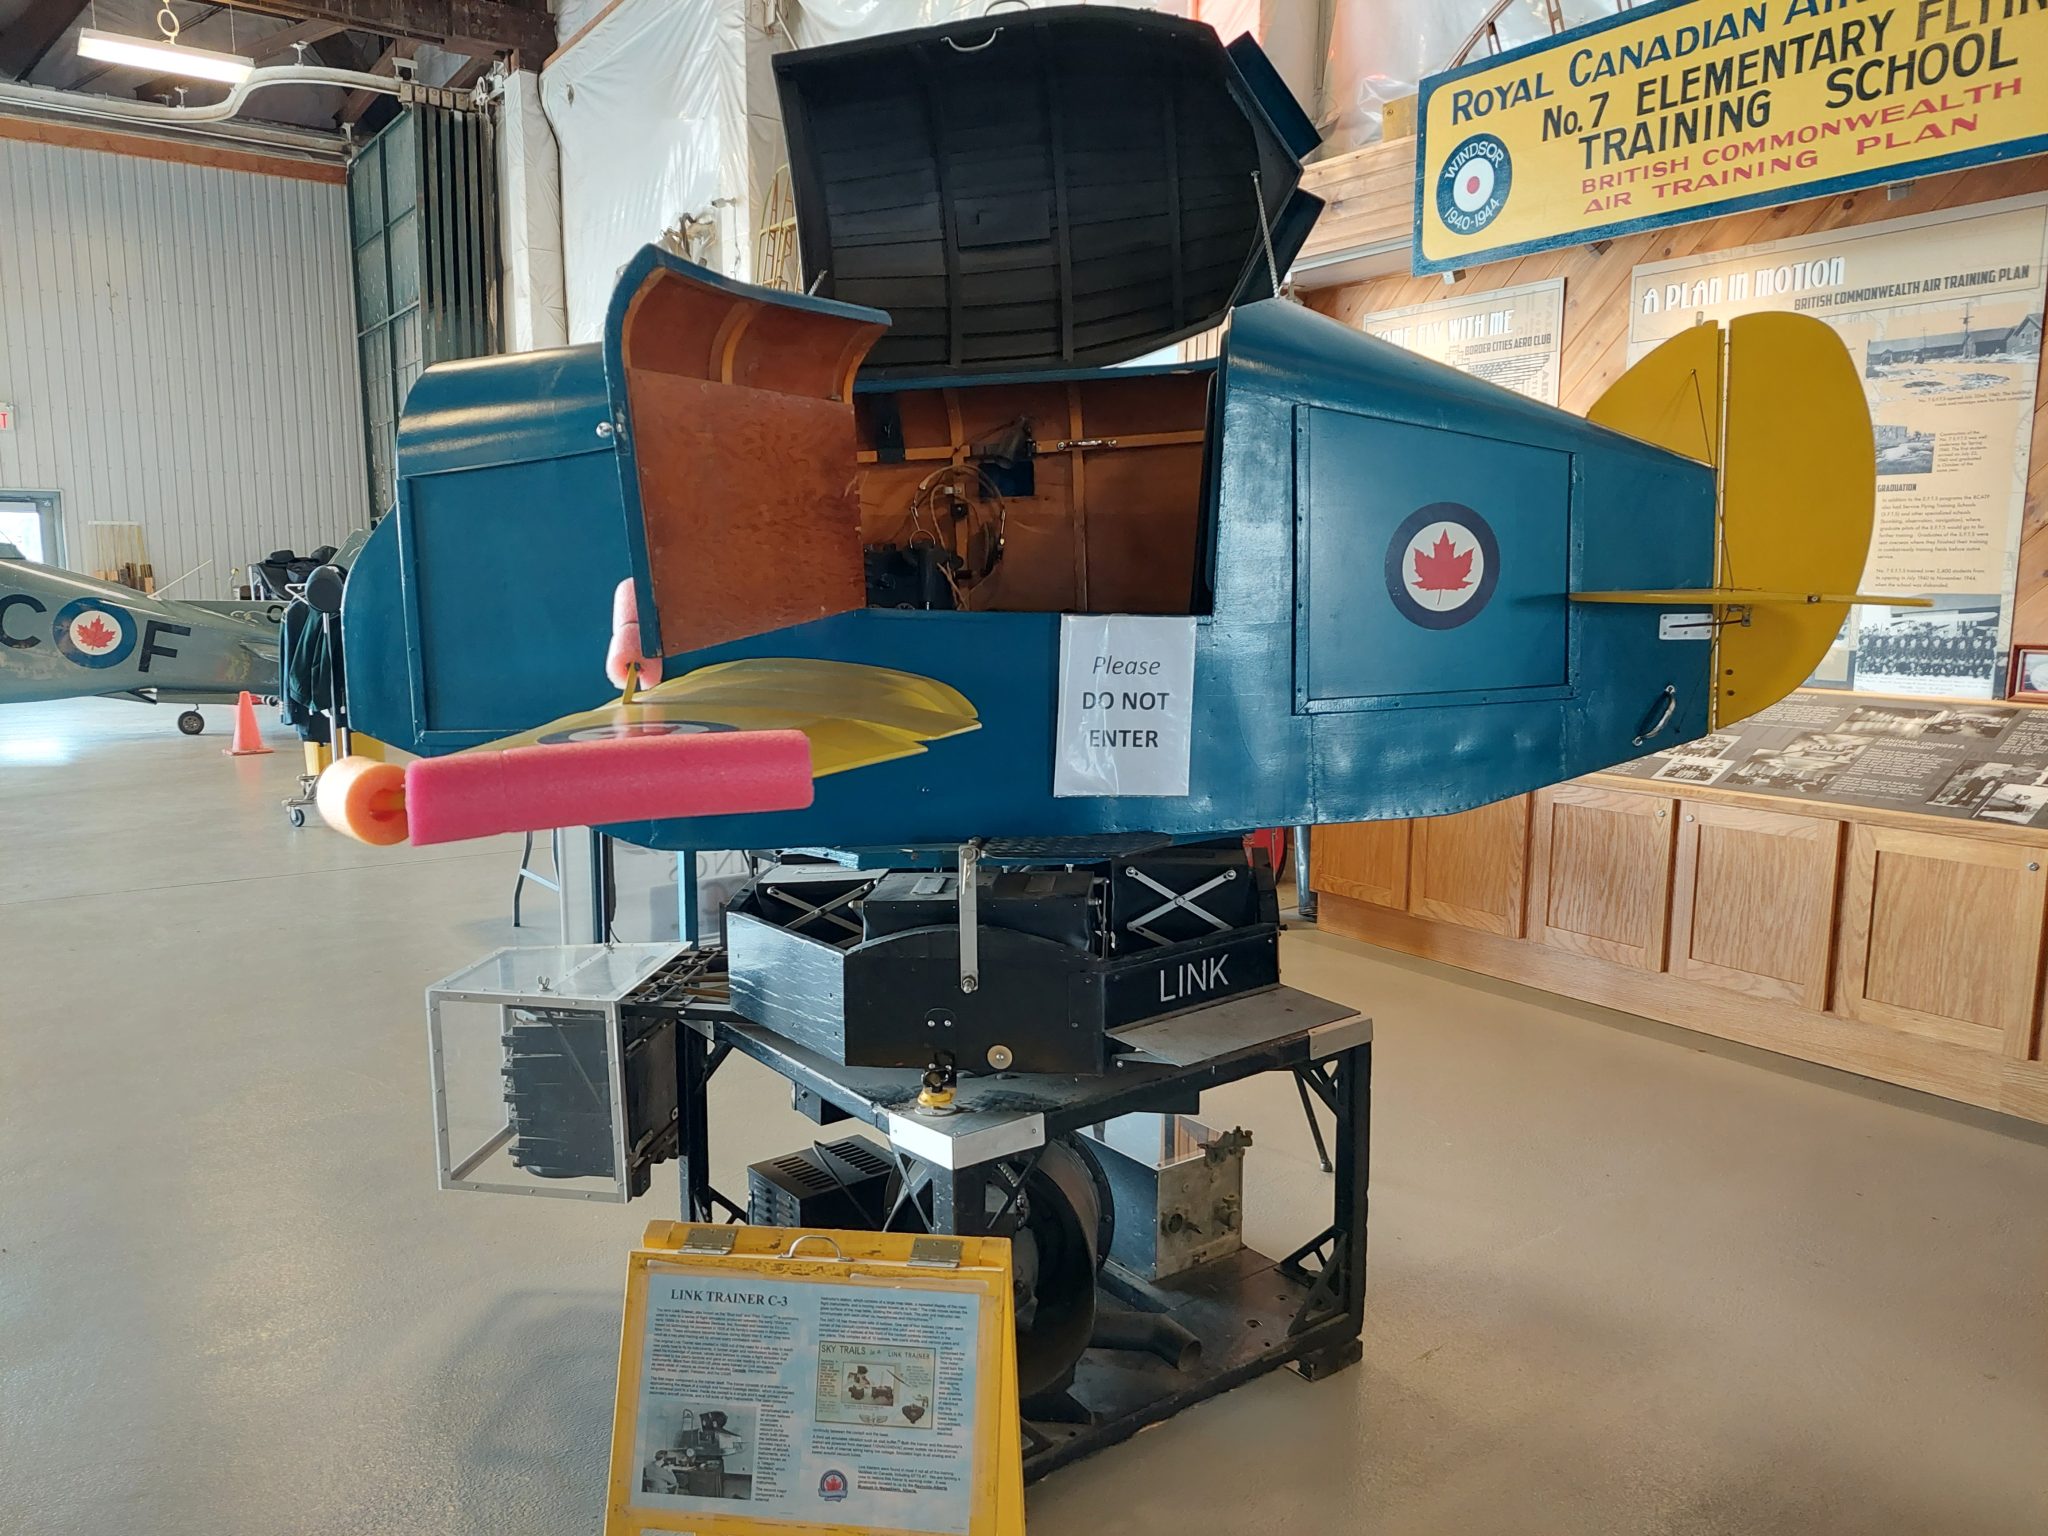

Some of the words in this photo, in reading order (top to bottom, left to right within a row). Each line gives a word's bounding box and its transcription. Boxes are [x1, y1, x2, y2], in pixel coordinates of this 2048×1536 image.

[1452, 72, 1554, 126] ROYAL
[1569, 3, 1767, 87] CANADIAN
[1636, 8, 1896, 117] ELEMENTARY
[1578, 89, 1771, 170] TRAINING
[1825, 26, 2018, 110] SCHOOL
[1582, 156, 1689, 195] BRITISH
[1703, 77, 2022, 166] COMMONWEALTH
[1444, 140, 1504, 179] WINDSOR
[1583, 191, 1632, 215] AIR
[1652, 150, 1818, 199] TRAINING
[1856, 113, 1979, 156] PLAN
[1444, 198, 1500, 231] 1940-1944
[1642, 287, 1660, 315] A
[1664, 276, 1722, 312] PLAN
[1728, 272, 1750, 303] IN
[1755, 256, 1846, 298] MOTION
[1794, 294, 1832, 311] BRITISH
[1834, 280, 1920, 306] COMMONWEALTH
[1922, 277, 1941, 293] AIR
[1943, 268, 1996, 290] TRAINING
[1998, 264, 2030, 283] PLAN
[1448, 314, 1485, 343] WITH
[1488, 309, 1515, 336] ME
[1464, 342, 1491, 356] BORDER
[1492, 340, 1513, 352] CITIES
[1514, 336, 1532, 349] AERO
[1533, 333, 1552, 346] CLUB
[1877, 483, 1917, 492] GRADUATION
[138, 620, 191, 673] F
[1092, 655, 1161, 675] Please
[1083, 692, 1114, 710] DO
[1122, 692, 1170, 710] NOT
[1090, 730, 1158, 748] ENTER
[1160, 954, 1230, 1002] LINK
[671, 1289, 703, 1301] LINK
[706, 1291, 765, 1305] TRAINER
[768, 1295, 788, 1307] C-3
[821, 1344, 836, 1353] SKY
[839, 1345, 866, 1355] TRAILS
[905, 1352, 930, 1360] TRAINER
